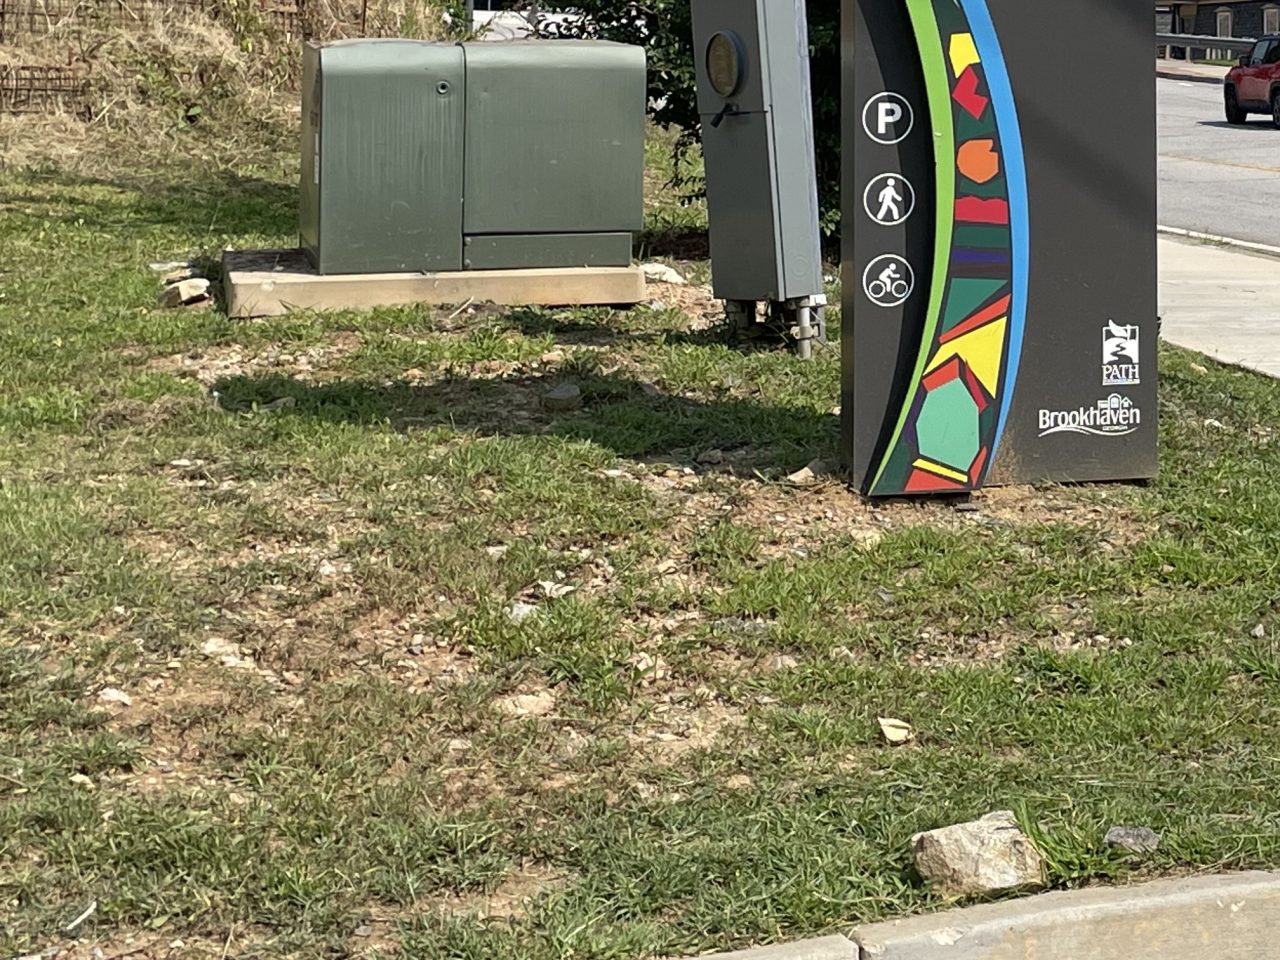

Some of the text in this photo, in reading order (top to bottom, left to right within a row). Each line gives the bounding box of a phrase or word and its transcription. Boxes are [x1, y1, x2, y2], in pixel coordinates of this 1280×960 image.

[877, 102, 902, 134] P
[1101, 363, 1140, 380] PATH
[1038, 406, 1141, 429] Brookhaven
